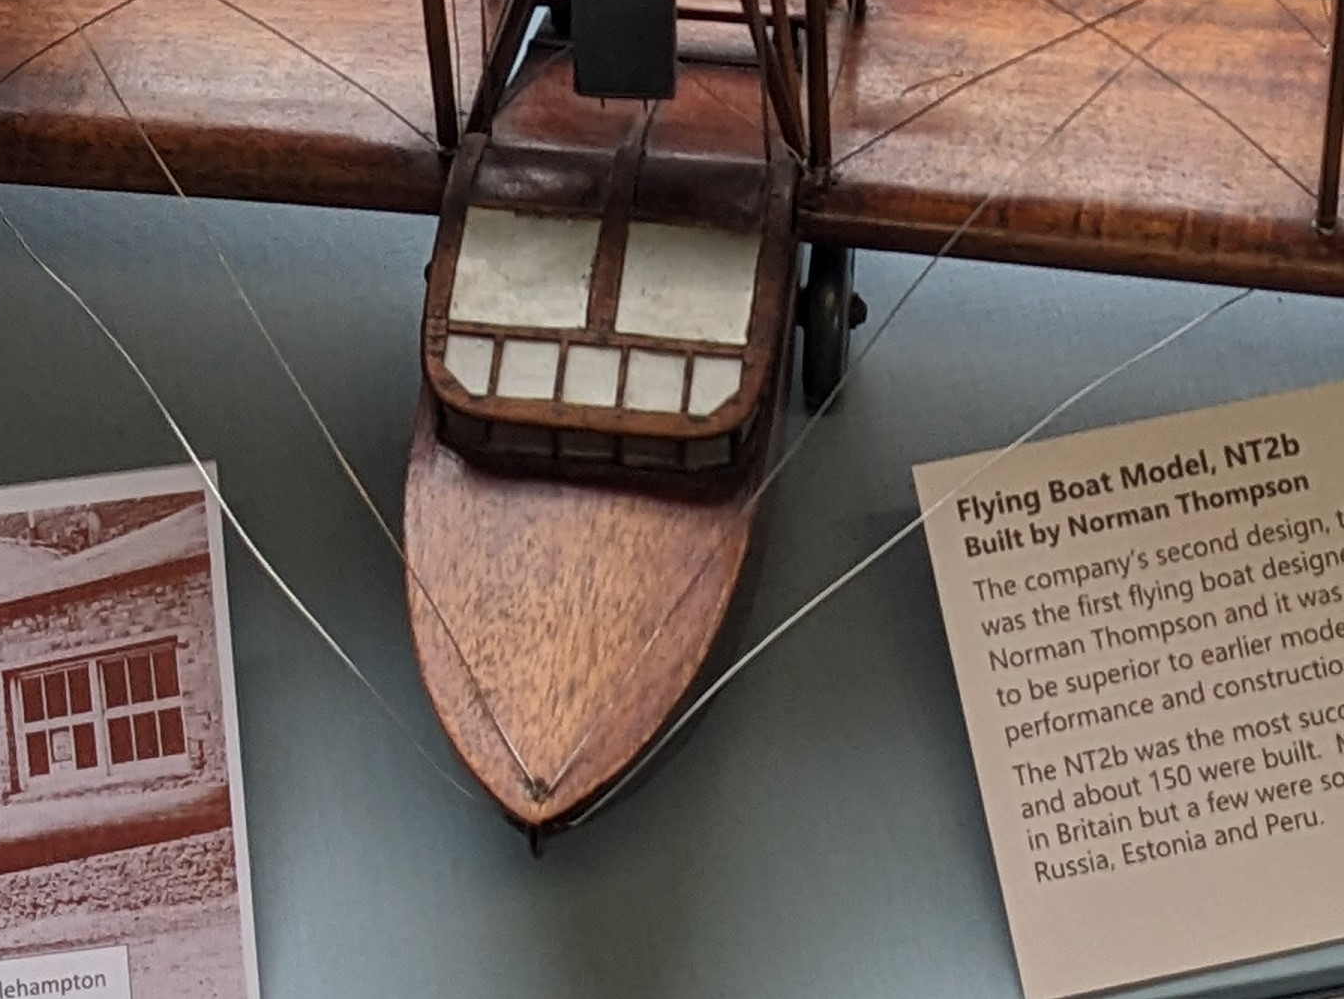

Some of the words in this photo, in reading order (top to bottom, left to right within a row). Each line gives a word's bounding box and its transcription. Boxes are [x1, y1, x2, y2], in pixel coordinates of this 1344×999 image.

[955, 488, 1042, 525] Flying
[1046, 471, 1115, 504] Boat
[1118, 450, 1217, 490] Model,
[1222, 435, 1301, 470] NT2b
[962, 526, 1025, 559] Built
[1027, 521, 1061, 549] by
[1066, 501, 1171, 538] Norman
[1173, 473, 1310, 516] Thompson
[971, 576, 1017, 602] The
[1023, 547, 1150, 592] company's
[1154, 526, 1240, 567] second
[1245, 516, 1331, 547] design,
[980, 612, 1027, 637] was
[1030, 601, 1071, 627] the
[1076, 589, 1123, 618] first
[1127, 578, 1195, 612] flying
[1198, 563, 1256, 593] boat
[987, 637, 1086, 672] Norman
[1089, 610, 1218, 651] Thompson
[1223, 592, 1269, 625] and
[1273, 591, 1293, 615] it
[1295, 584, 1343, 609] was
[995, 687, 1022, 708] to
[1026, 677, 1059, 701] be
[1064, 657, 1161, 695] superior
[1166, 652, 1194, 673] to
[1200, 633, 1273, 666] earlier
[1003, 696, 1154, 749] performance
[1160, 679, 1206, 711] and
